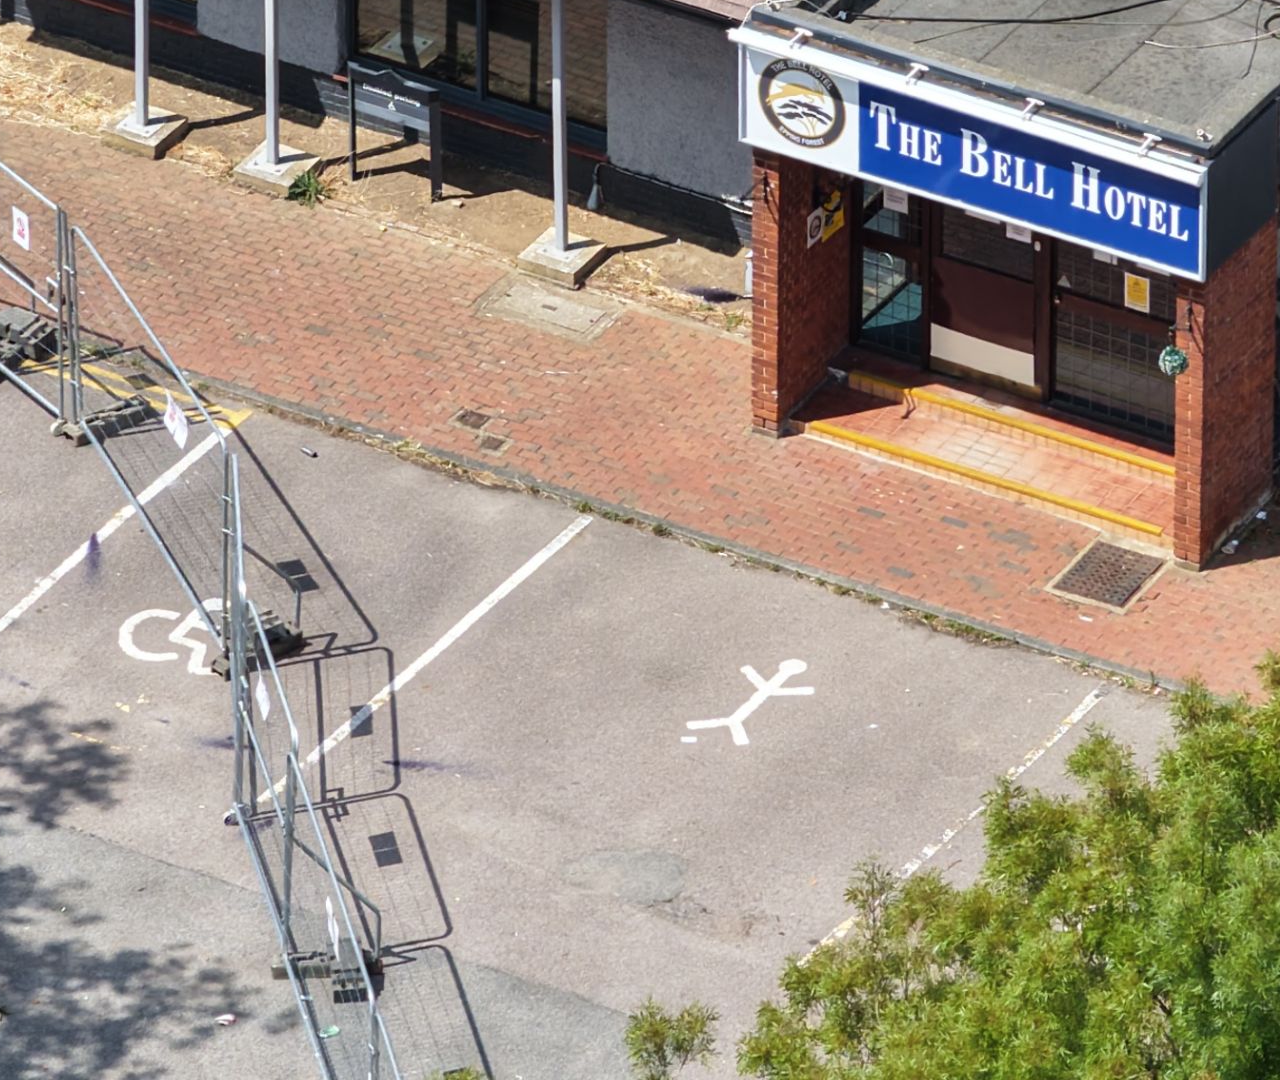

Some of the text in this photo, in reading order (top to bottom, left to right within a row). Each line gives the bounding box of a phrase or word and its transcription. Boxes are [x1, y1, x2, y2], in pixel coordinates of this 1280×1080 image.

[771, 60, 833, 90] THE BELL HOTEL
[869, 100, 1189, 242] THE BELL HOTEL
